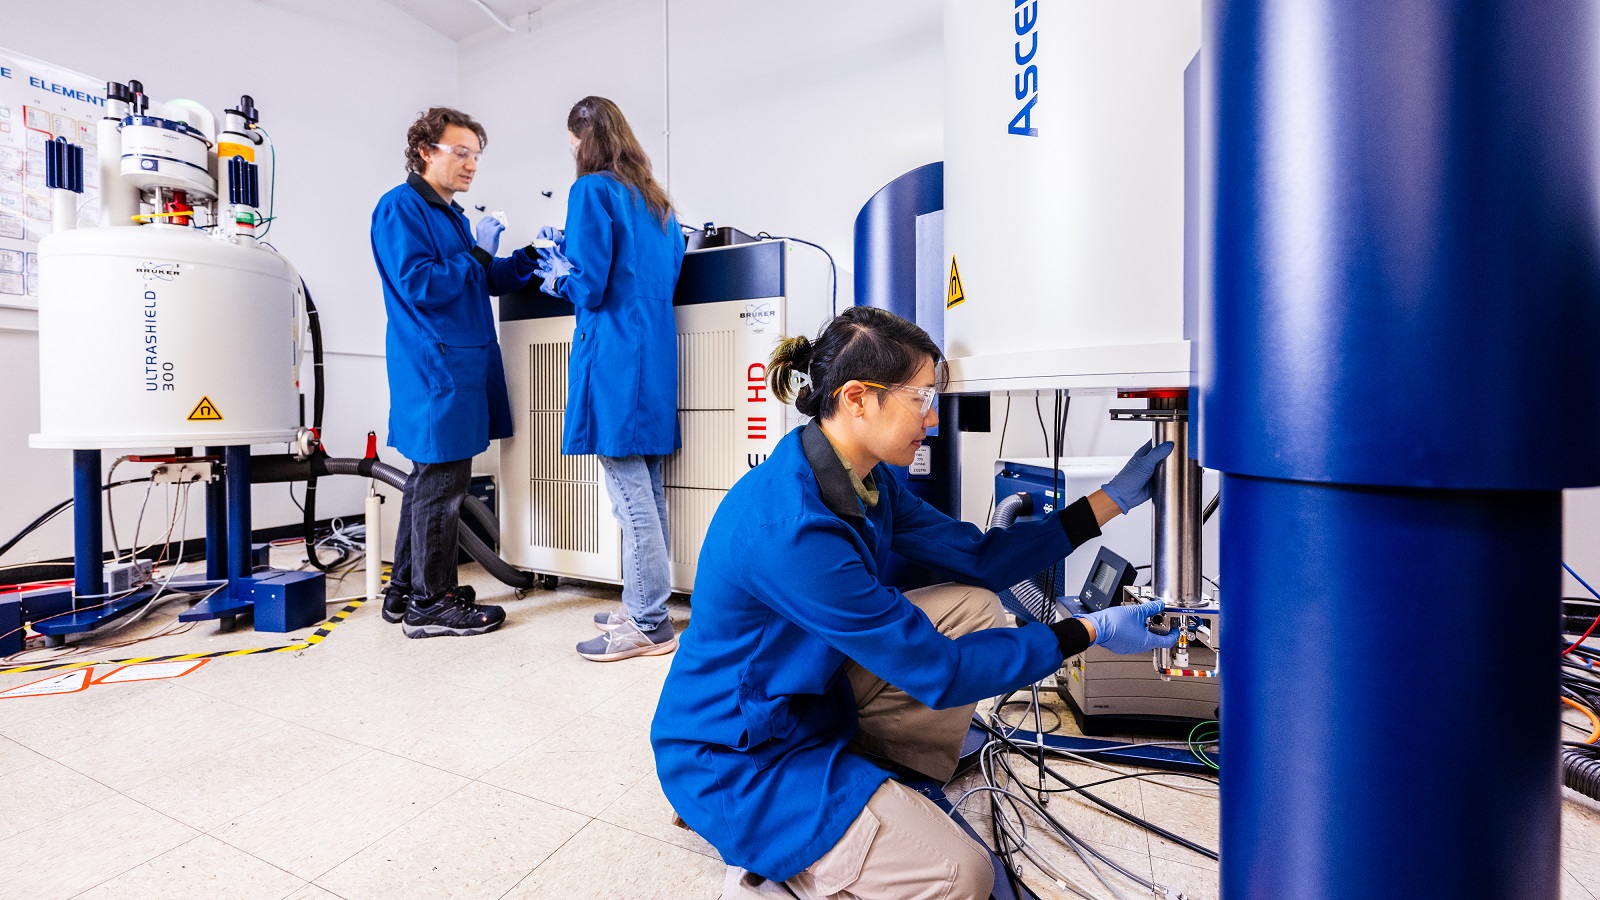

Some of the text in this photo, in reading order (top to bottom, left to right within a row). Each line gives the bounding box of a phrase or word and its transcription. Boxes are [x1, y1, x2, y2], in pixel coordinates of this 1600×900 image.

[1008, 0, 1038, 137] ASCE
[136, 267, 180, 276] BRUKER
[740, 310, 775, 319] BRUKER
[144, 290, 158, 391] ULTRASHIELD
[162, 362, 175, 391] 300
[747, 362, 767, 403] HD
